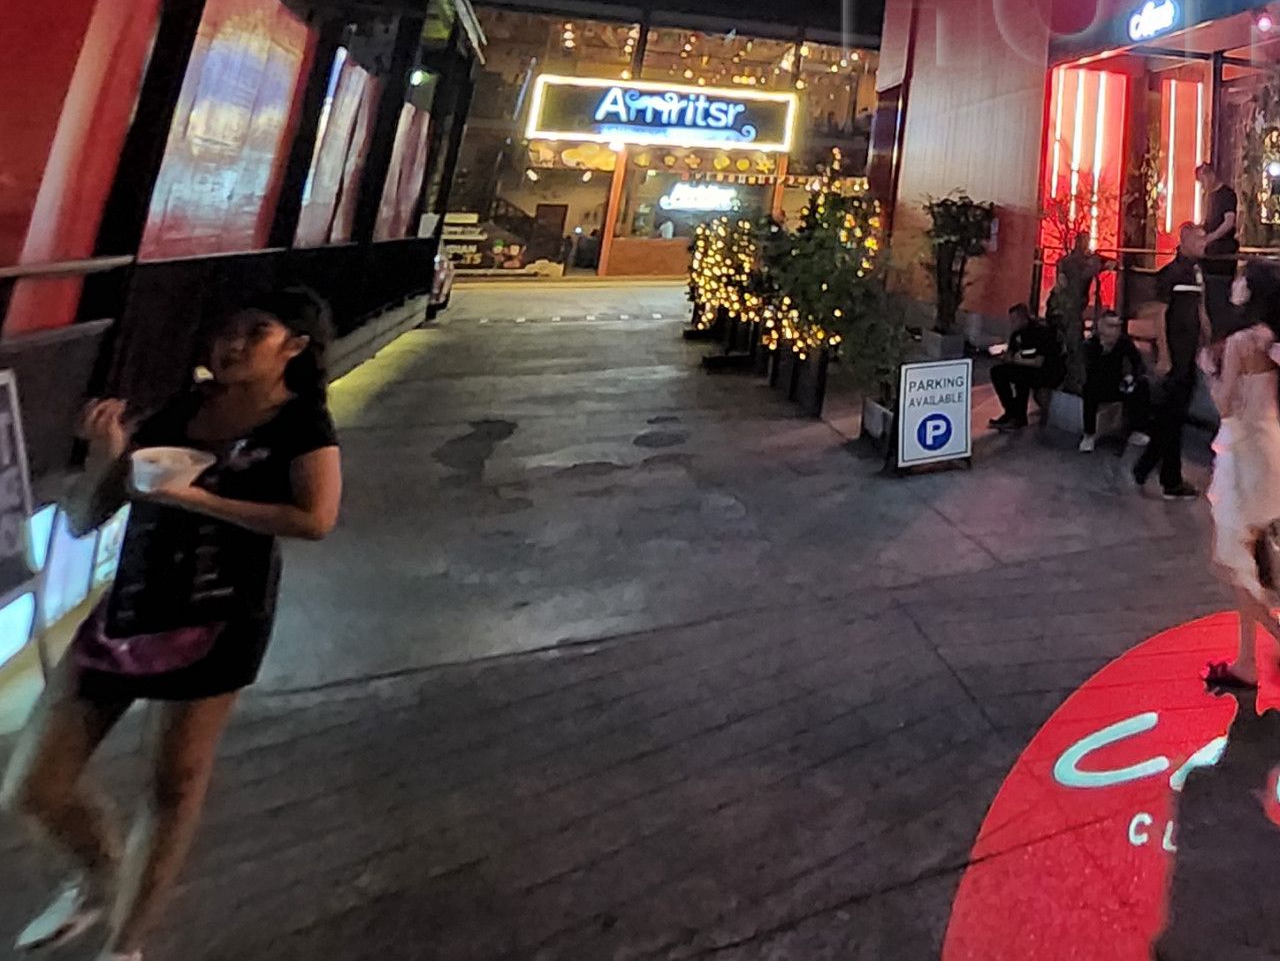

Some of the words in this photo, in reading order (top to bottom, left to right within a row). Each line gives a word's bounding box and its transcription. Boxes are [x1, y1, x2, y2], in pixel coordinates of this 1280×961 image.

[908, 376, 964, 393] PARKING
[908, 392, 964, 409] AVAILABLE
[925, 419, 948, 446] P
